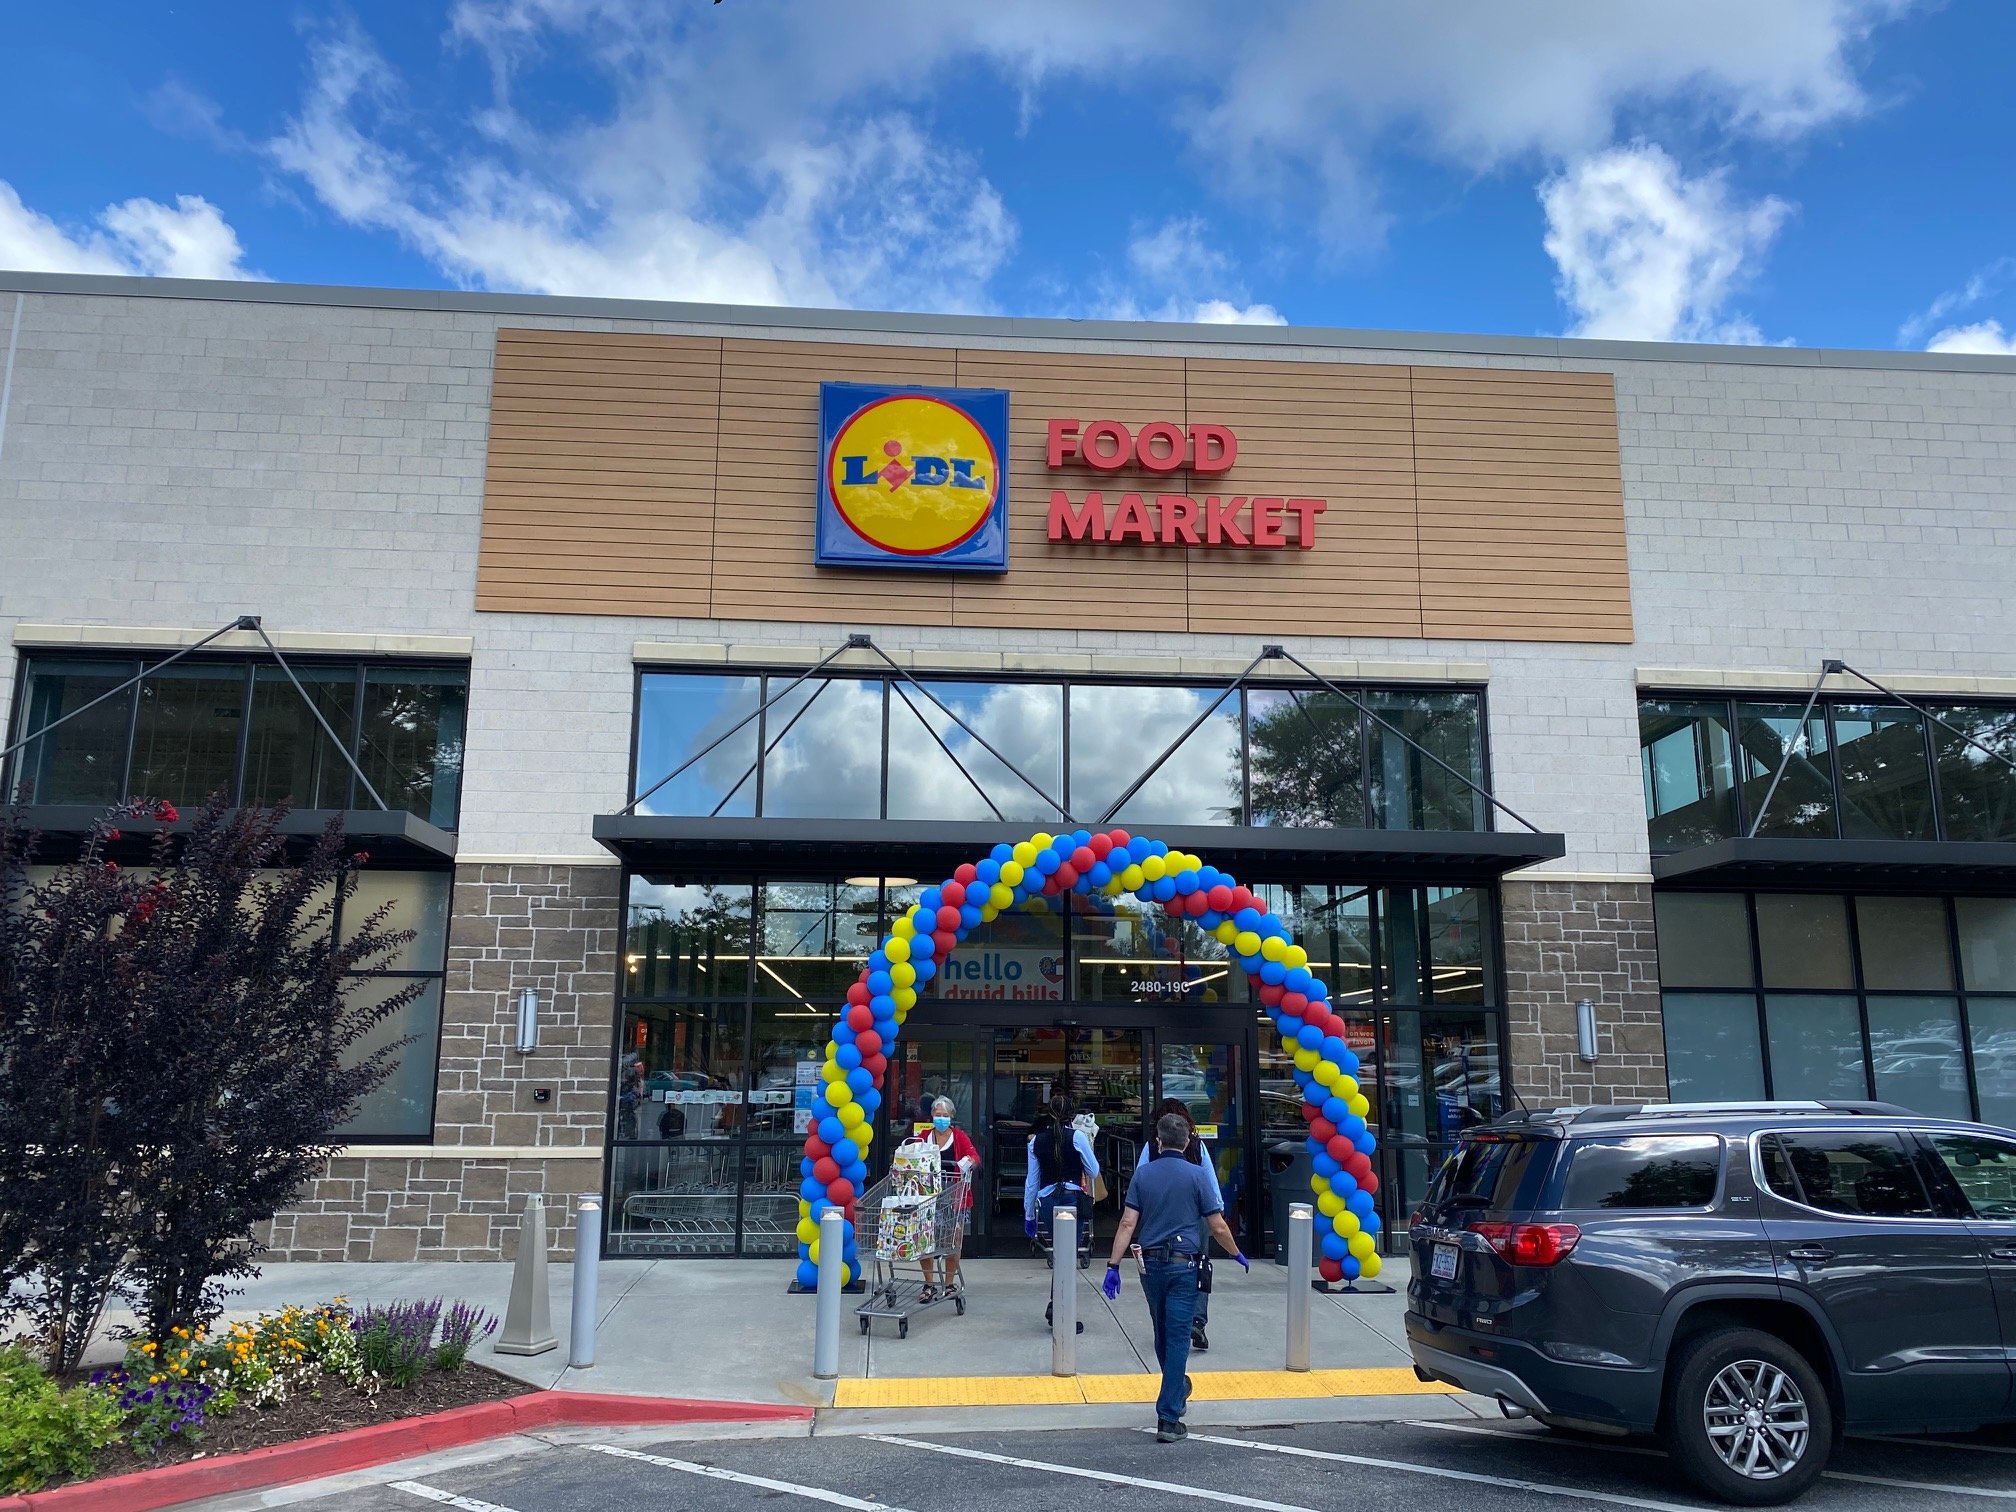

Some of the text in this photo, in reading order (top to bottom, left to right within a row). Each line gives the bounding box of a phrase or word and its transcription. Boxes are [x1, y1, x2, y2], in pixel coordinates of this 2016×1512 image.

[1046, 419, 1237, 474] FOOD
[1047, 491, 1327, 549] MARKET
[944, 953, 1022, 980] hello
[944, 984, 1059, 1000] druid hills
